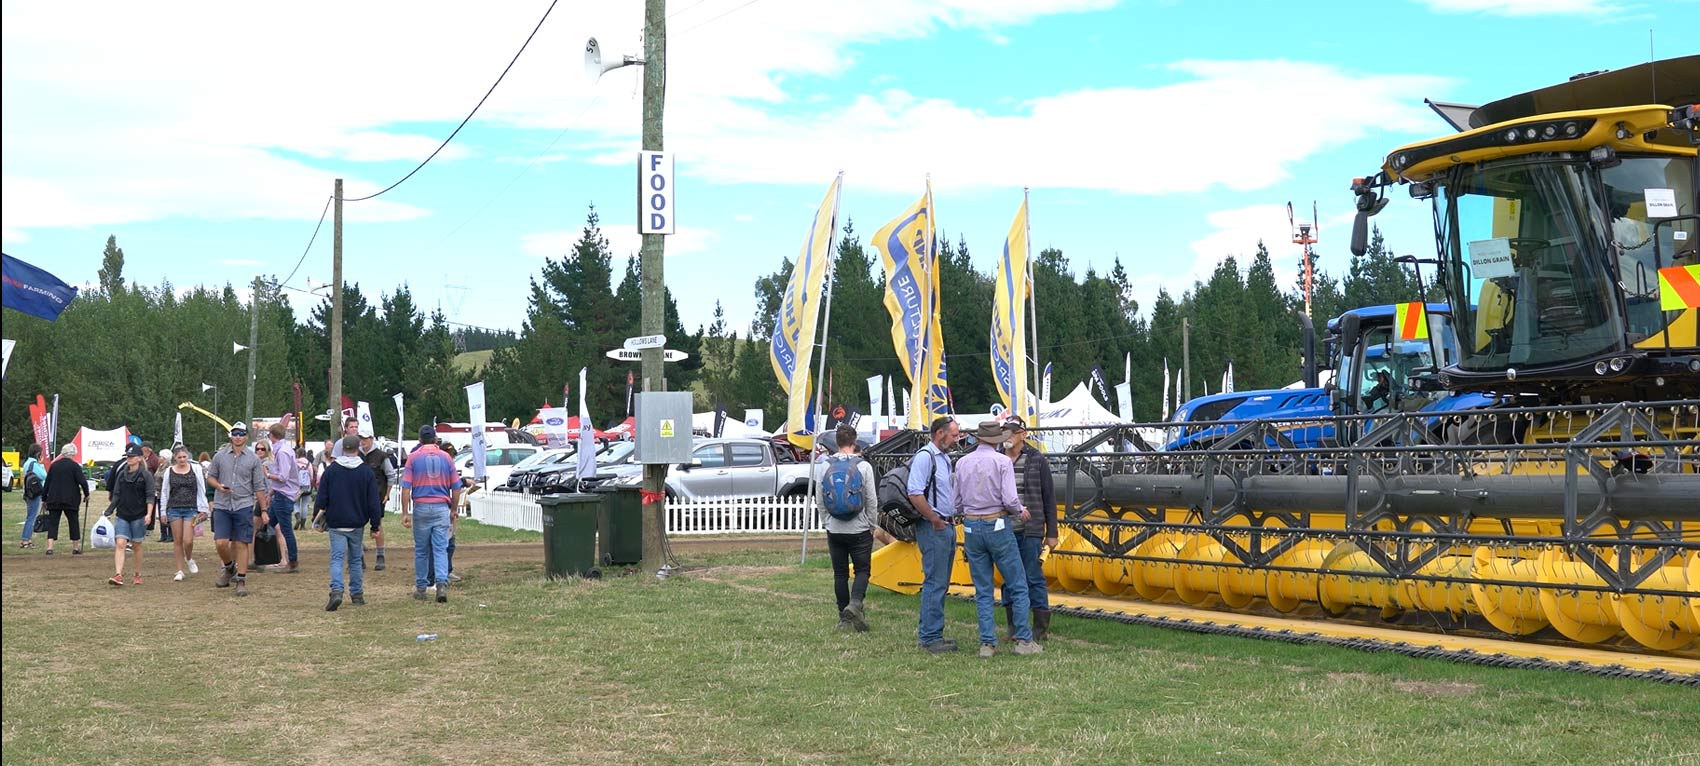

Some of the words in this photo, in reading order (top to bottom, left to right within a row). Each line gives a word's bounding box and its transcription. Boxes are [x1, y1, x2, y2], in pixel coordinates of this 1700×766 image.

[650, 154, 666, 230] FOOD
[1472, 258, 1491, 266] DILLON
[1493, 255, 1510, 263] GRAIN
